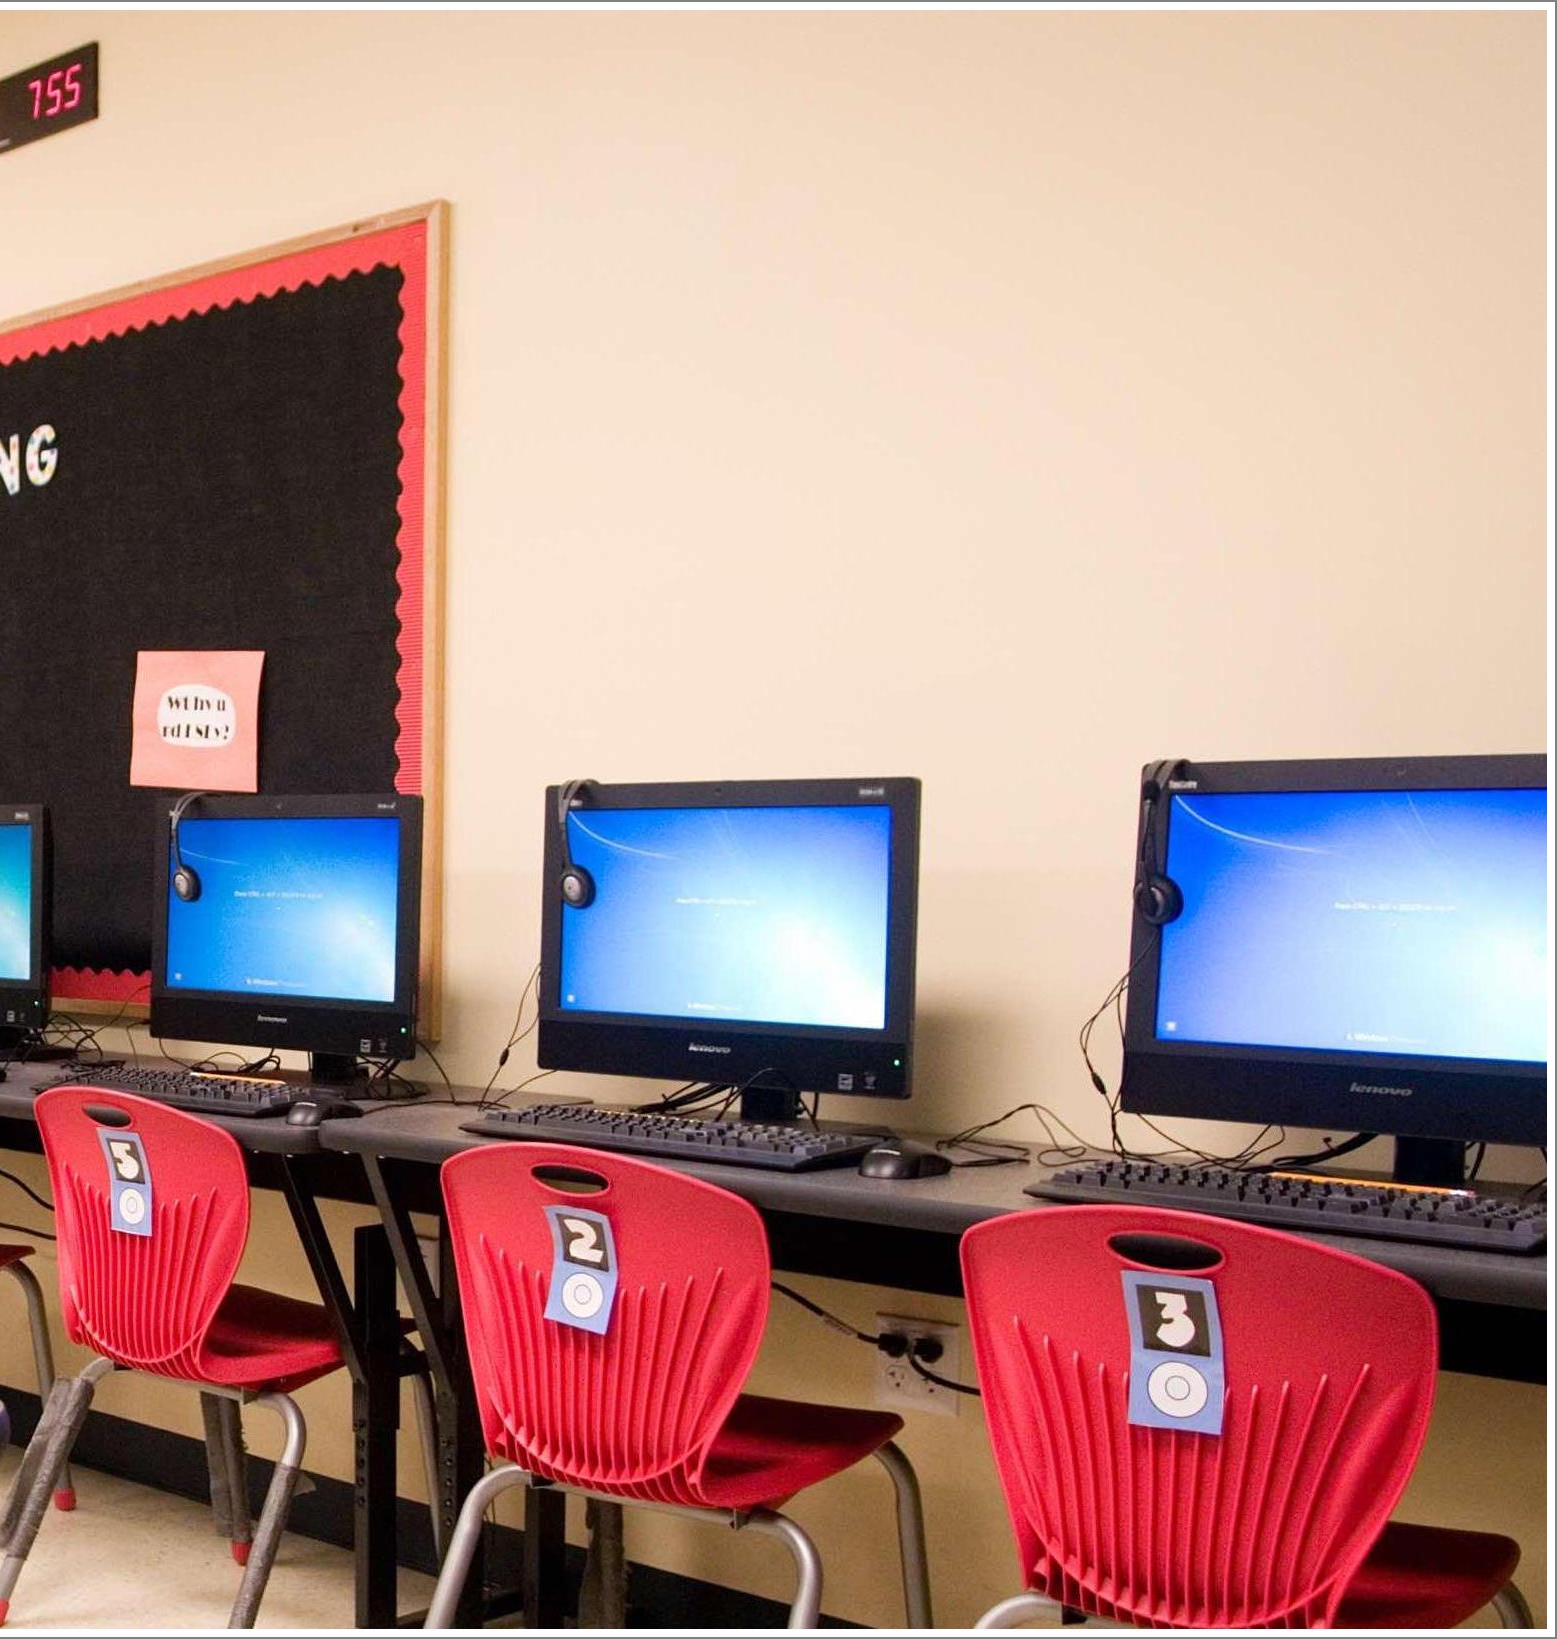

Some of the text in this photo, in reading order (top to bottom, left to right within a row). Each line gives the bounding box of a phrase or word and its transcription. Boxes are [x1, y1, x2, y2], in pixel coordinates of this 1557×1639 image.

[28, 63, 82, 119] 755
[1349, 1081, 1413, 1097] lenovo
[109, 1141, 140, 1180] 5
[563, 1218, 604, 1263] 2
[1154, 1291, 1196, 1348] 3
